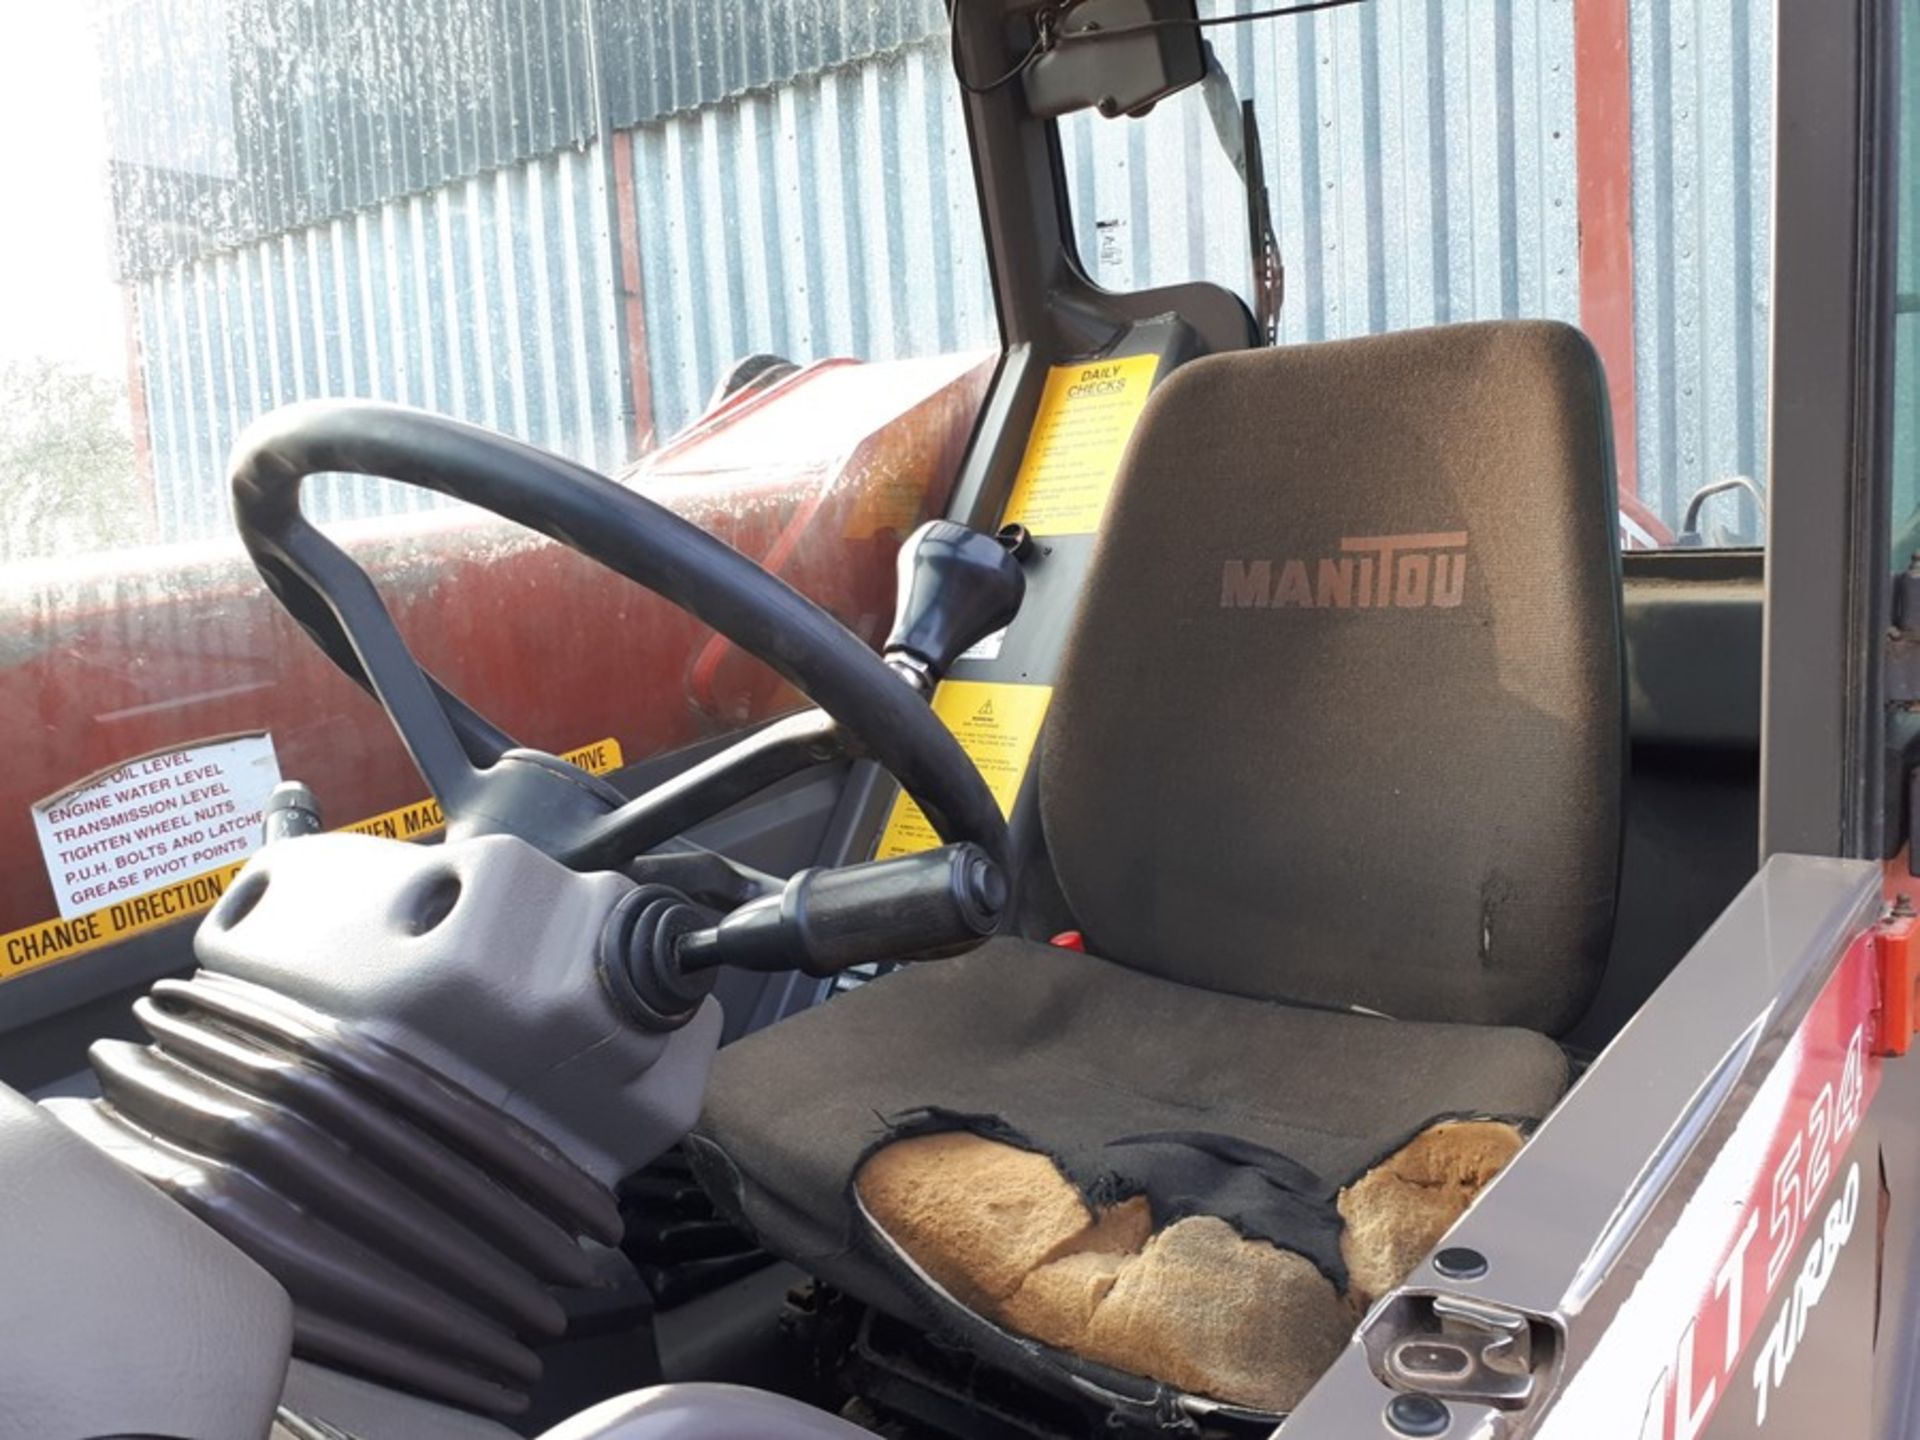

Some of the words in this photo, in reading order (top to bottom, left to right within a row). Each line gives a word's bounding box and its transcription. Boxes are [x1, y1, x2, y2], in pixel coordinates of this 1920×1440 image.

[1067, 378, 1126, 398] CHECKS
[1081, 365, 1121, 382] DAILY
[1220, 531, 1468, 608] MANITOU
[48, 795, 112, 825] ENGINE
[114, 777, 171, 803] WATER
[174, 763, 224, 787] LEVEL
[110, 767, 139, 784] OIL
[142, 752, 193, 775] LEVEL
[53, 797, 178, 845] TRANSMISSION
[181, 782, 231, 806] LEVEL
[59, 833, 132, 865] TIGHTEN
[134, 816, 192, 842] WHEEL
[194, 799, 236, 822] NUTS
[6, 913, 102, 966] CHANGE
[110, 875, 223, 931] DIRECTION
[565, 746, 606, 772] OVE
[65, 862, 112, 885] P.U.H.
[115, 842, 168, 869] BOLTS
[172, 832, 205, 850] AND
[70, 871, 140, 905] GREASE
[143, 856, 188, 880] PIVOT
[192, 836, 248, 864] POINTS
[1765, 1022, 1864, 1294] 524
[1752, 1162, 1859, 1427] TURBO
